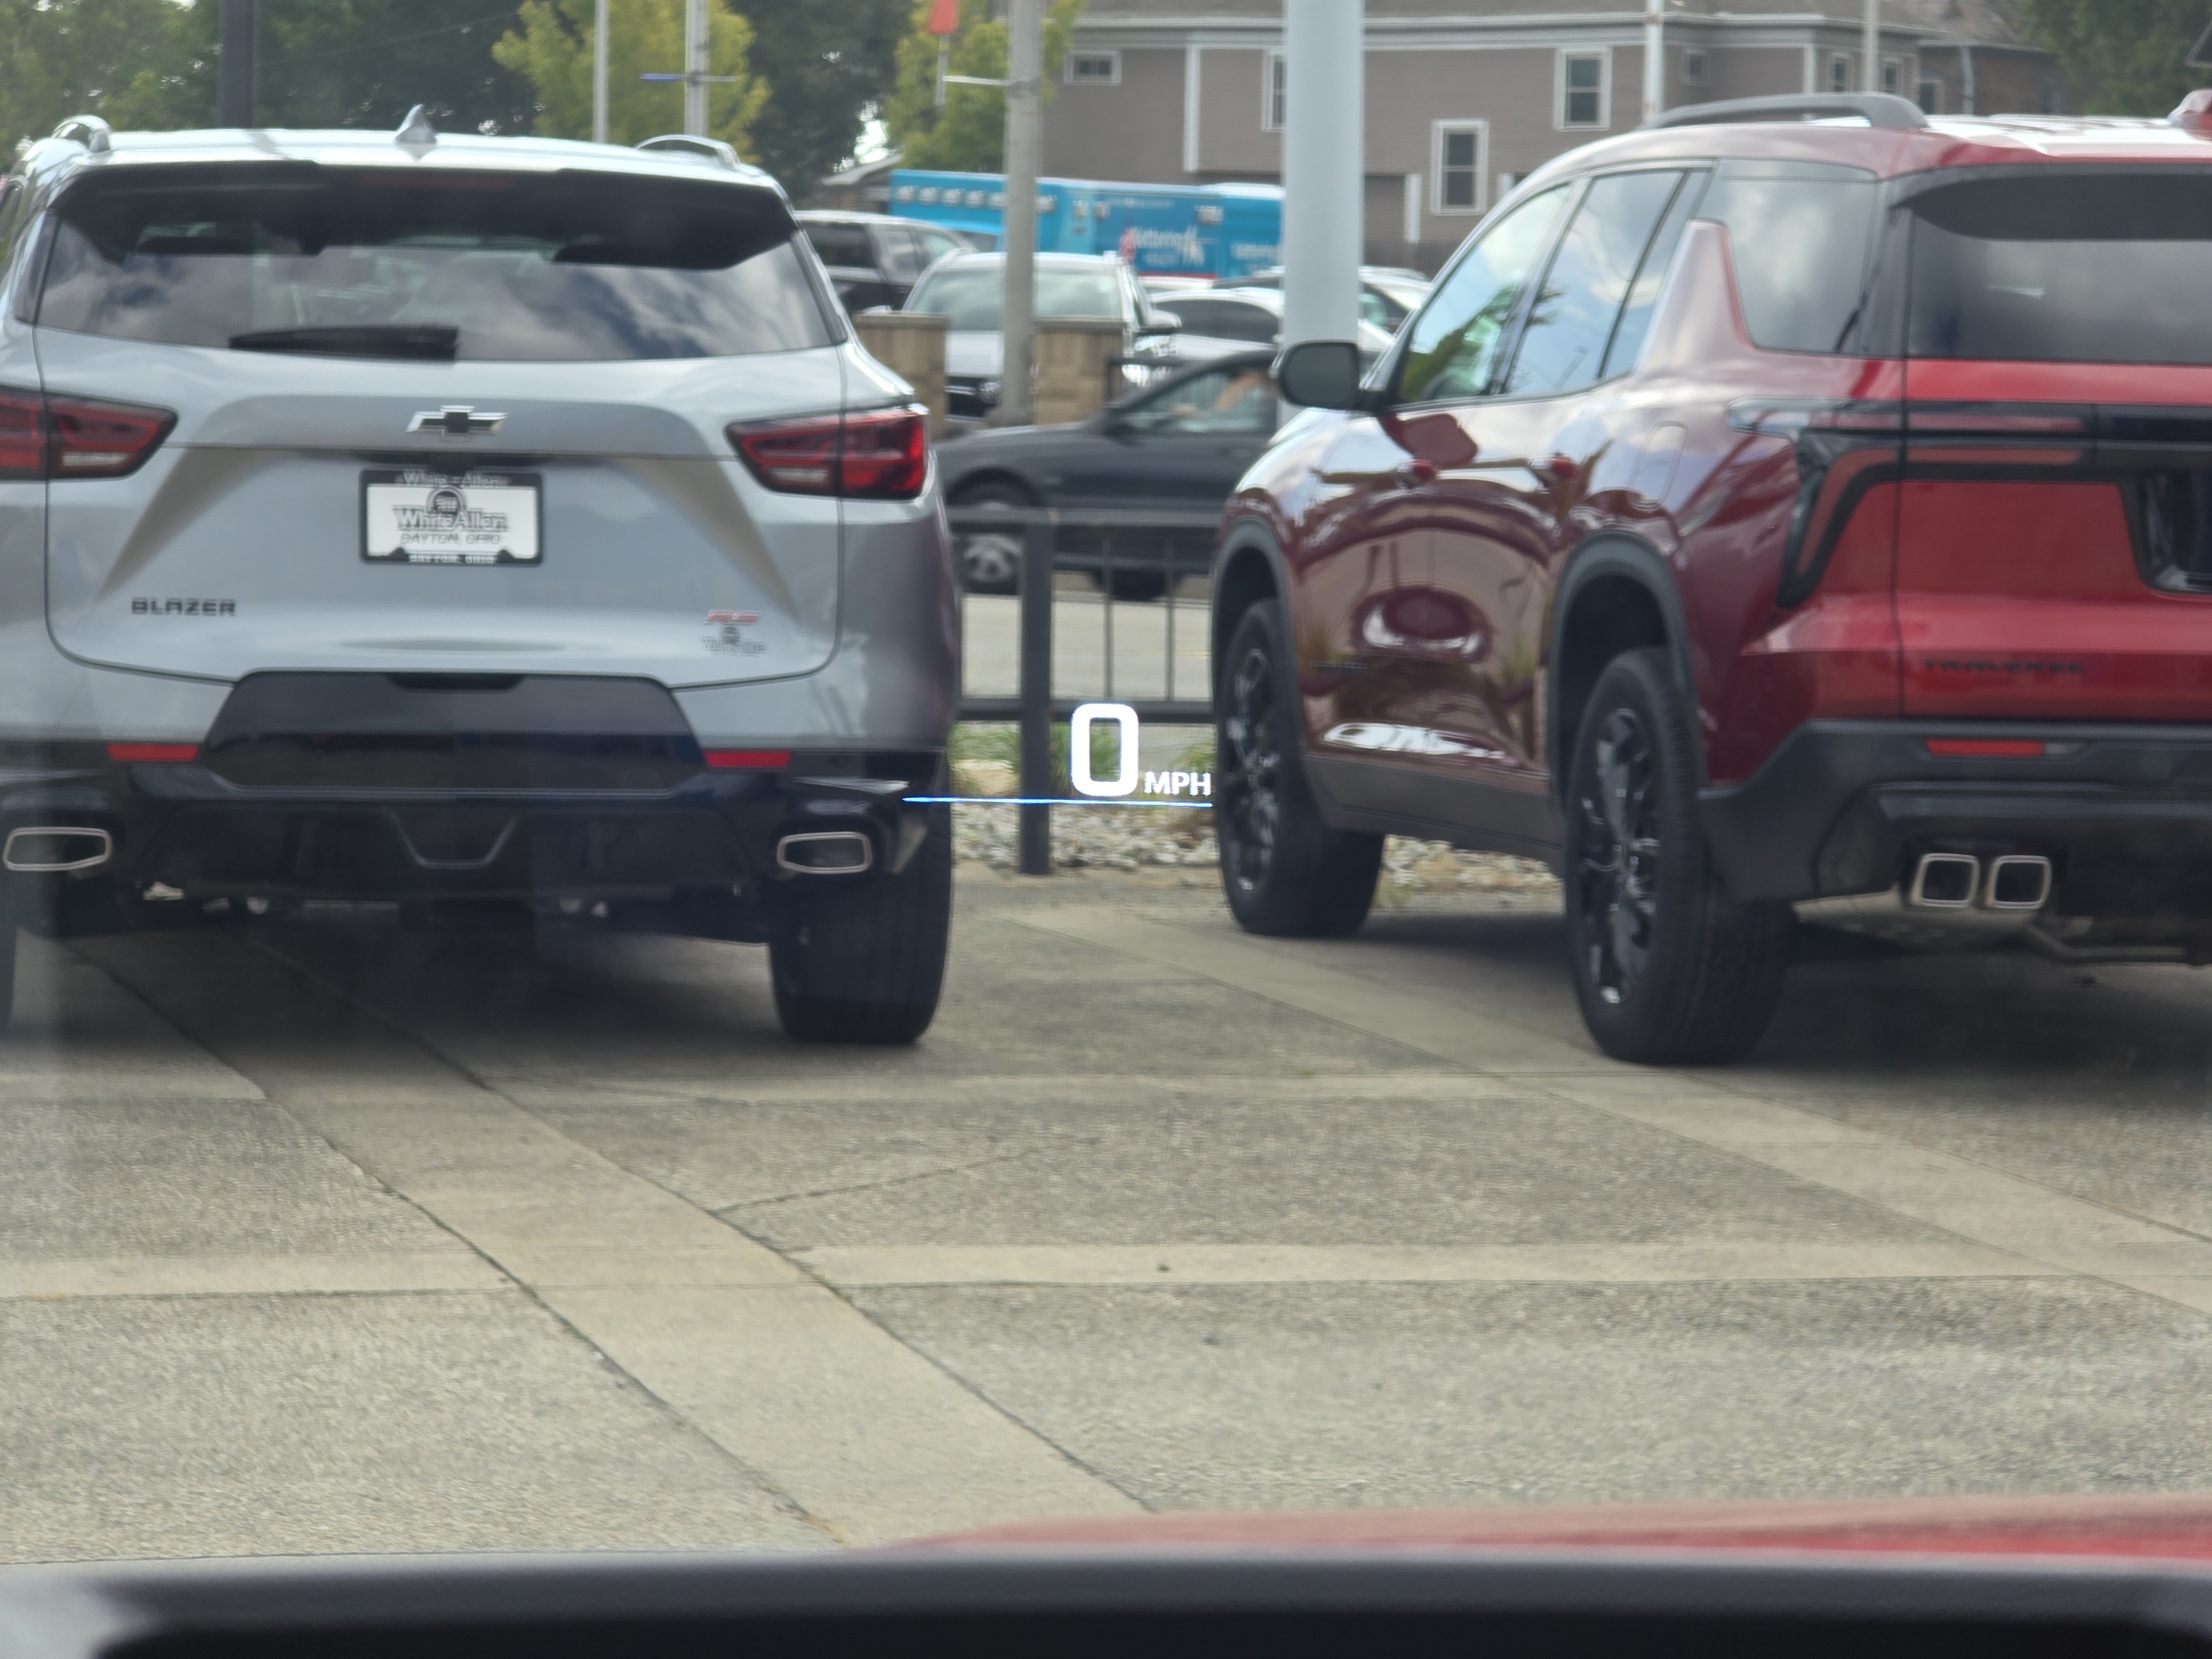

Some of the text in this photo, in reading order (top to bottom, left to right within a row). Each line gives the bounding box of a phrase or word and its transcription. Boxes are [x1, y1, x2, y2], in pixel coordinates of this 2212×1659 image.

[466, 534, 500, 545] OHIO
[132, 597, 236, 616] BLAZER
[1071, 703, 1211, 796] 0 MPH
